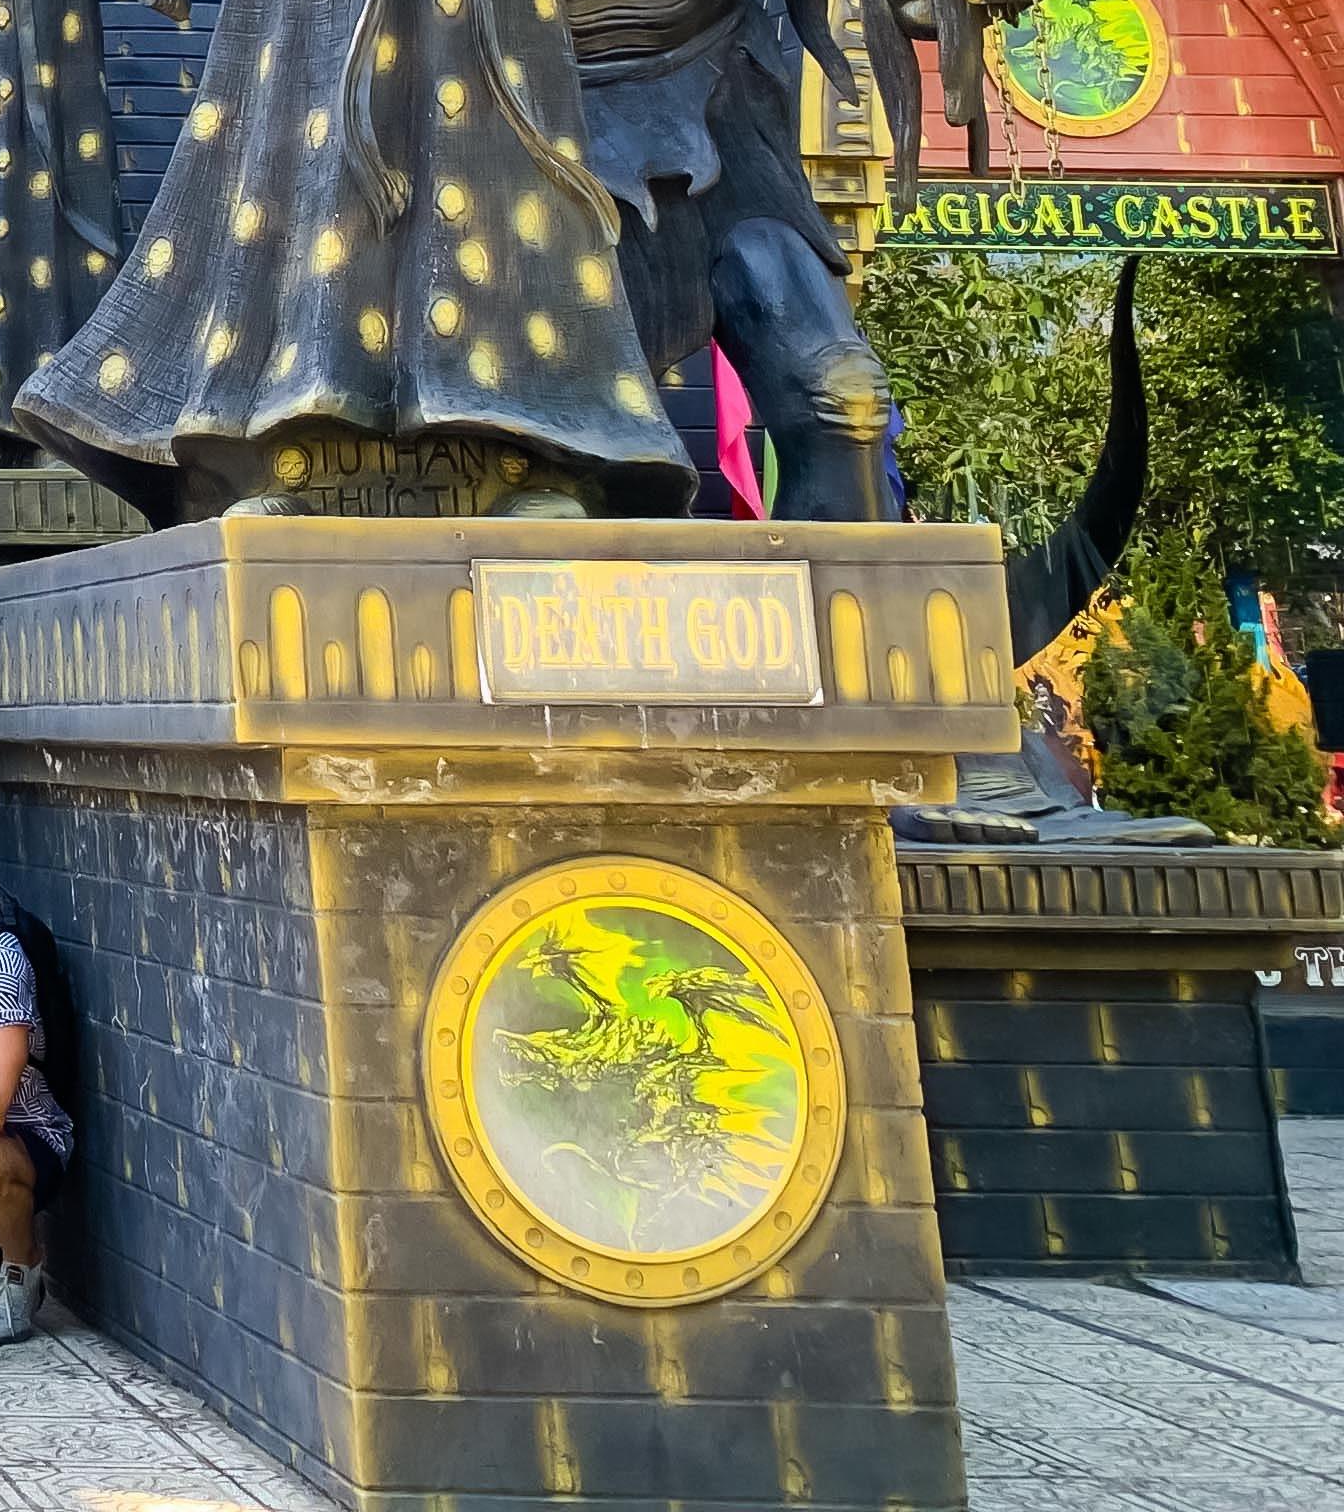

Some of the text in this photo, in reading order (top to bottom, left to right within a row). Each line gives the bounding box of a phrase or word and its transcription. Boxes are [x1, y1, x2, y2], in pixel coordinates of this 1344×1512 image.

[1114, 194, 1325, 240] CASTLE
[499, 595, 795, 672] DEATH GOD
